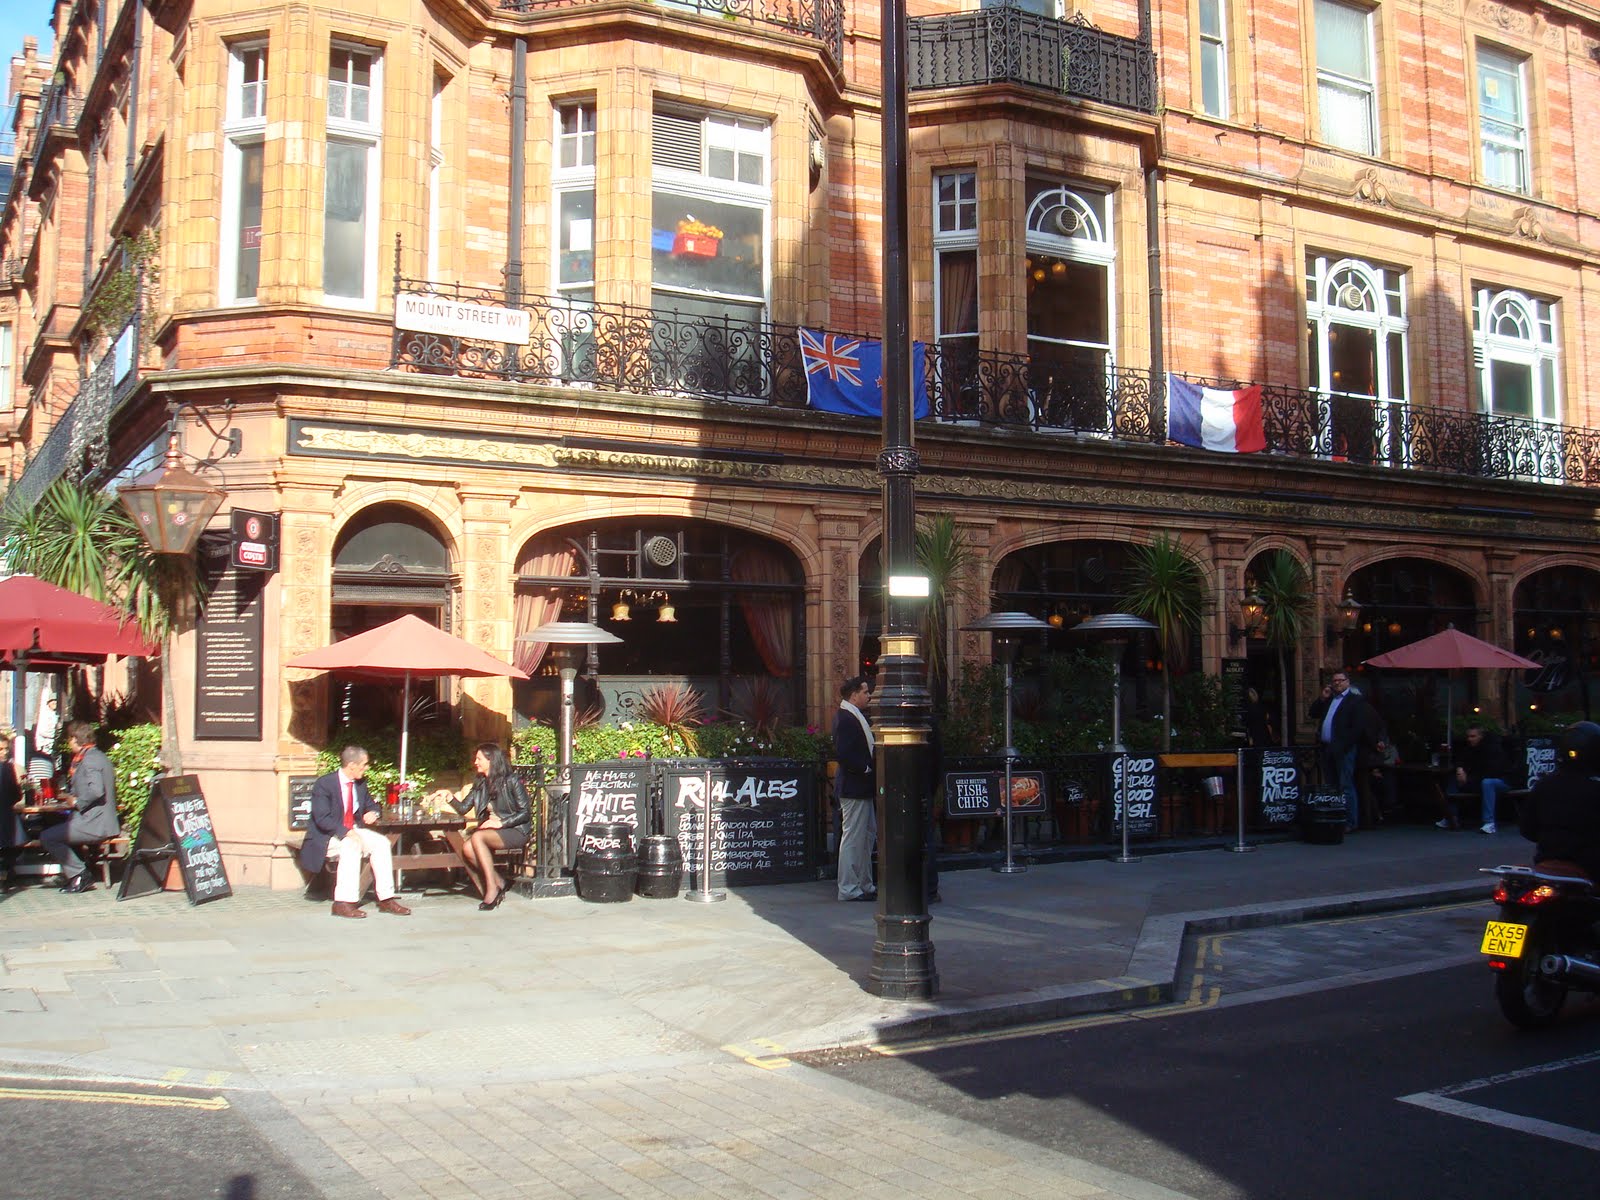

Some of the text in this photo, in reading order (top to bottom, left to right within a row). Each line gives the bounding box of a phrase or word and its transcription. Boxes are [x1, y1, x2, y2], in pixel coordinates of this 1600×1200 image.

[405, 301, 522, 328] MOUNT STREET W1
[1112, 757, 1155, 774] GOOD
[602, 770, 628, 781] HAVE
[1113, 774, 1156, 789] FIDAY.
[1261, 766, 1296, 789] RED
[580, 780, 631, 791] SELECTION
[734, 776, 798, 808] ALES
[1113, 789, 1154, 804] GOOD
[1261, 785, 1299, 803] WINES
[575, 789, 637, 816] WHITE
[957, 796, 989, 809] CHIPS
[717, 821, 749, 831] LONDON
[750, 820, 774, 829] GOLD
[738, 829, 755, 840] IPA
[583, 834, 620, 851] PRIDE
[719, 841, 750, 850] LONDON
[752, 839, 777, 849] PRIDE
[712, 850, 770, 861] BOMBARDIER
[714, 861, 753, 872] CORNISH
[754, 859, 772, 869] ALE
[1486, 924, 1525, 940] KX59
[1487, 938, 1517, 953] ENT
